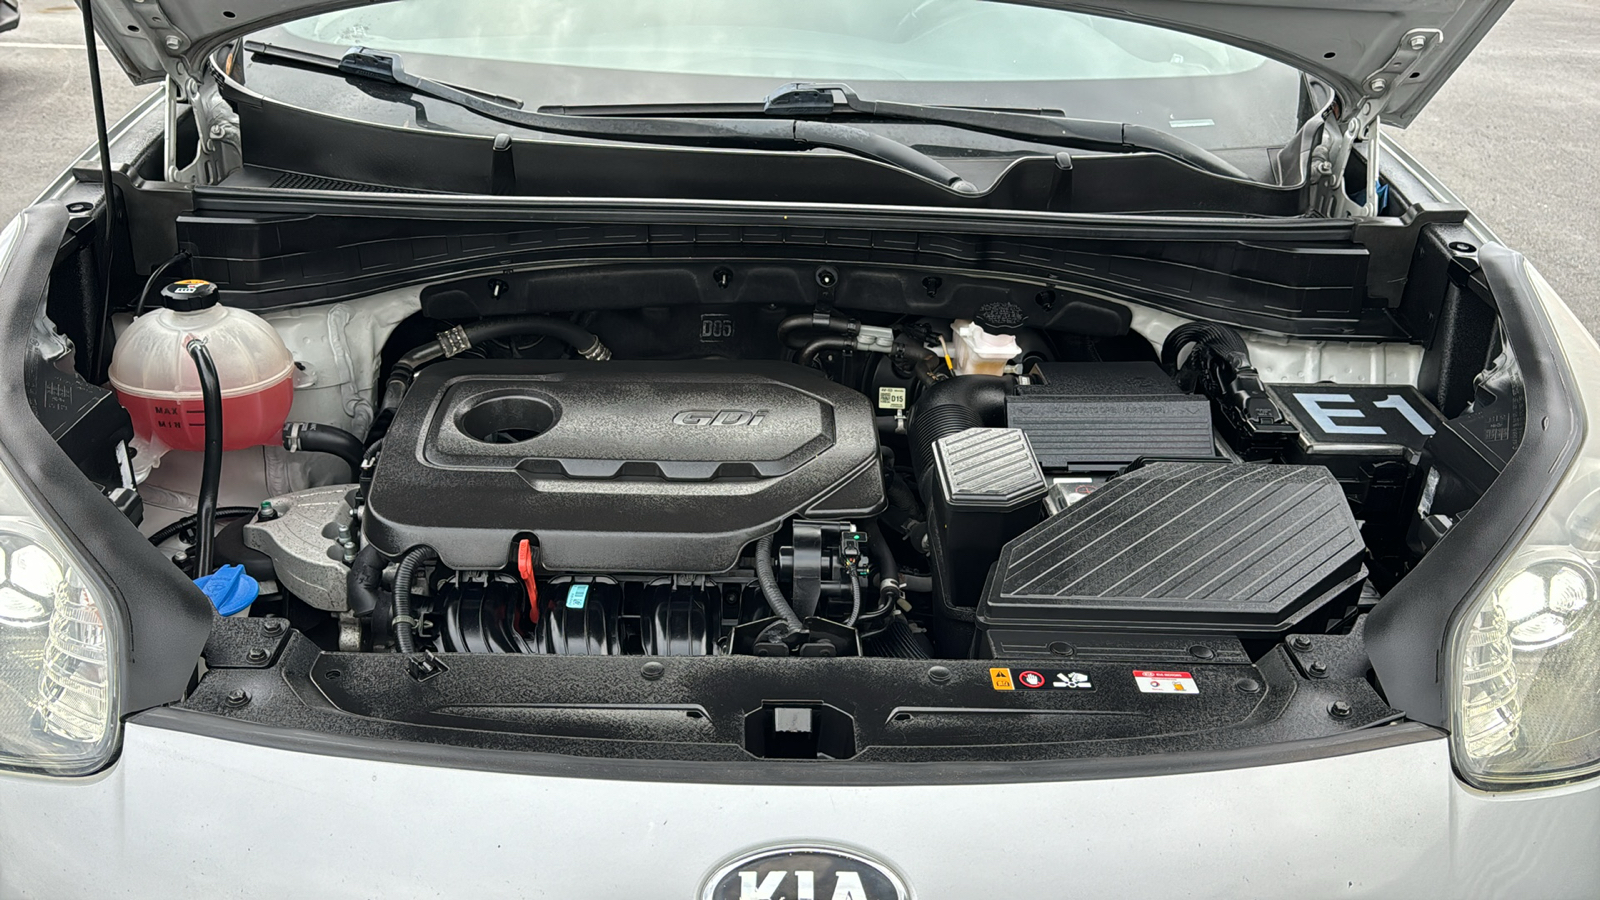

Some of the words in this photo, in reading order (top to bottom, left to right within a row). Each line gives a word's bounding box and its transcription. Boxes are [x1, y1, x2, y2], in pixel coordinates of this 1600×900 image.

[155, 406, 178, 415] MAX
[672, 409, 769, 426] GDi
[1292, 393, 1437, 436] E1
[738, 870, 868, 900] KIA
